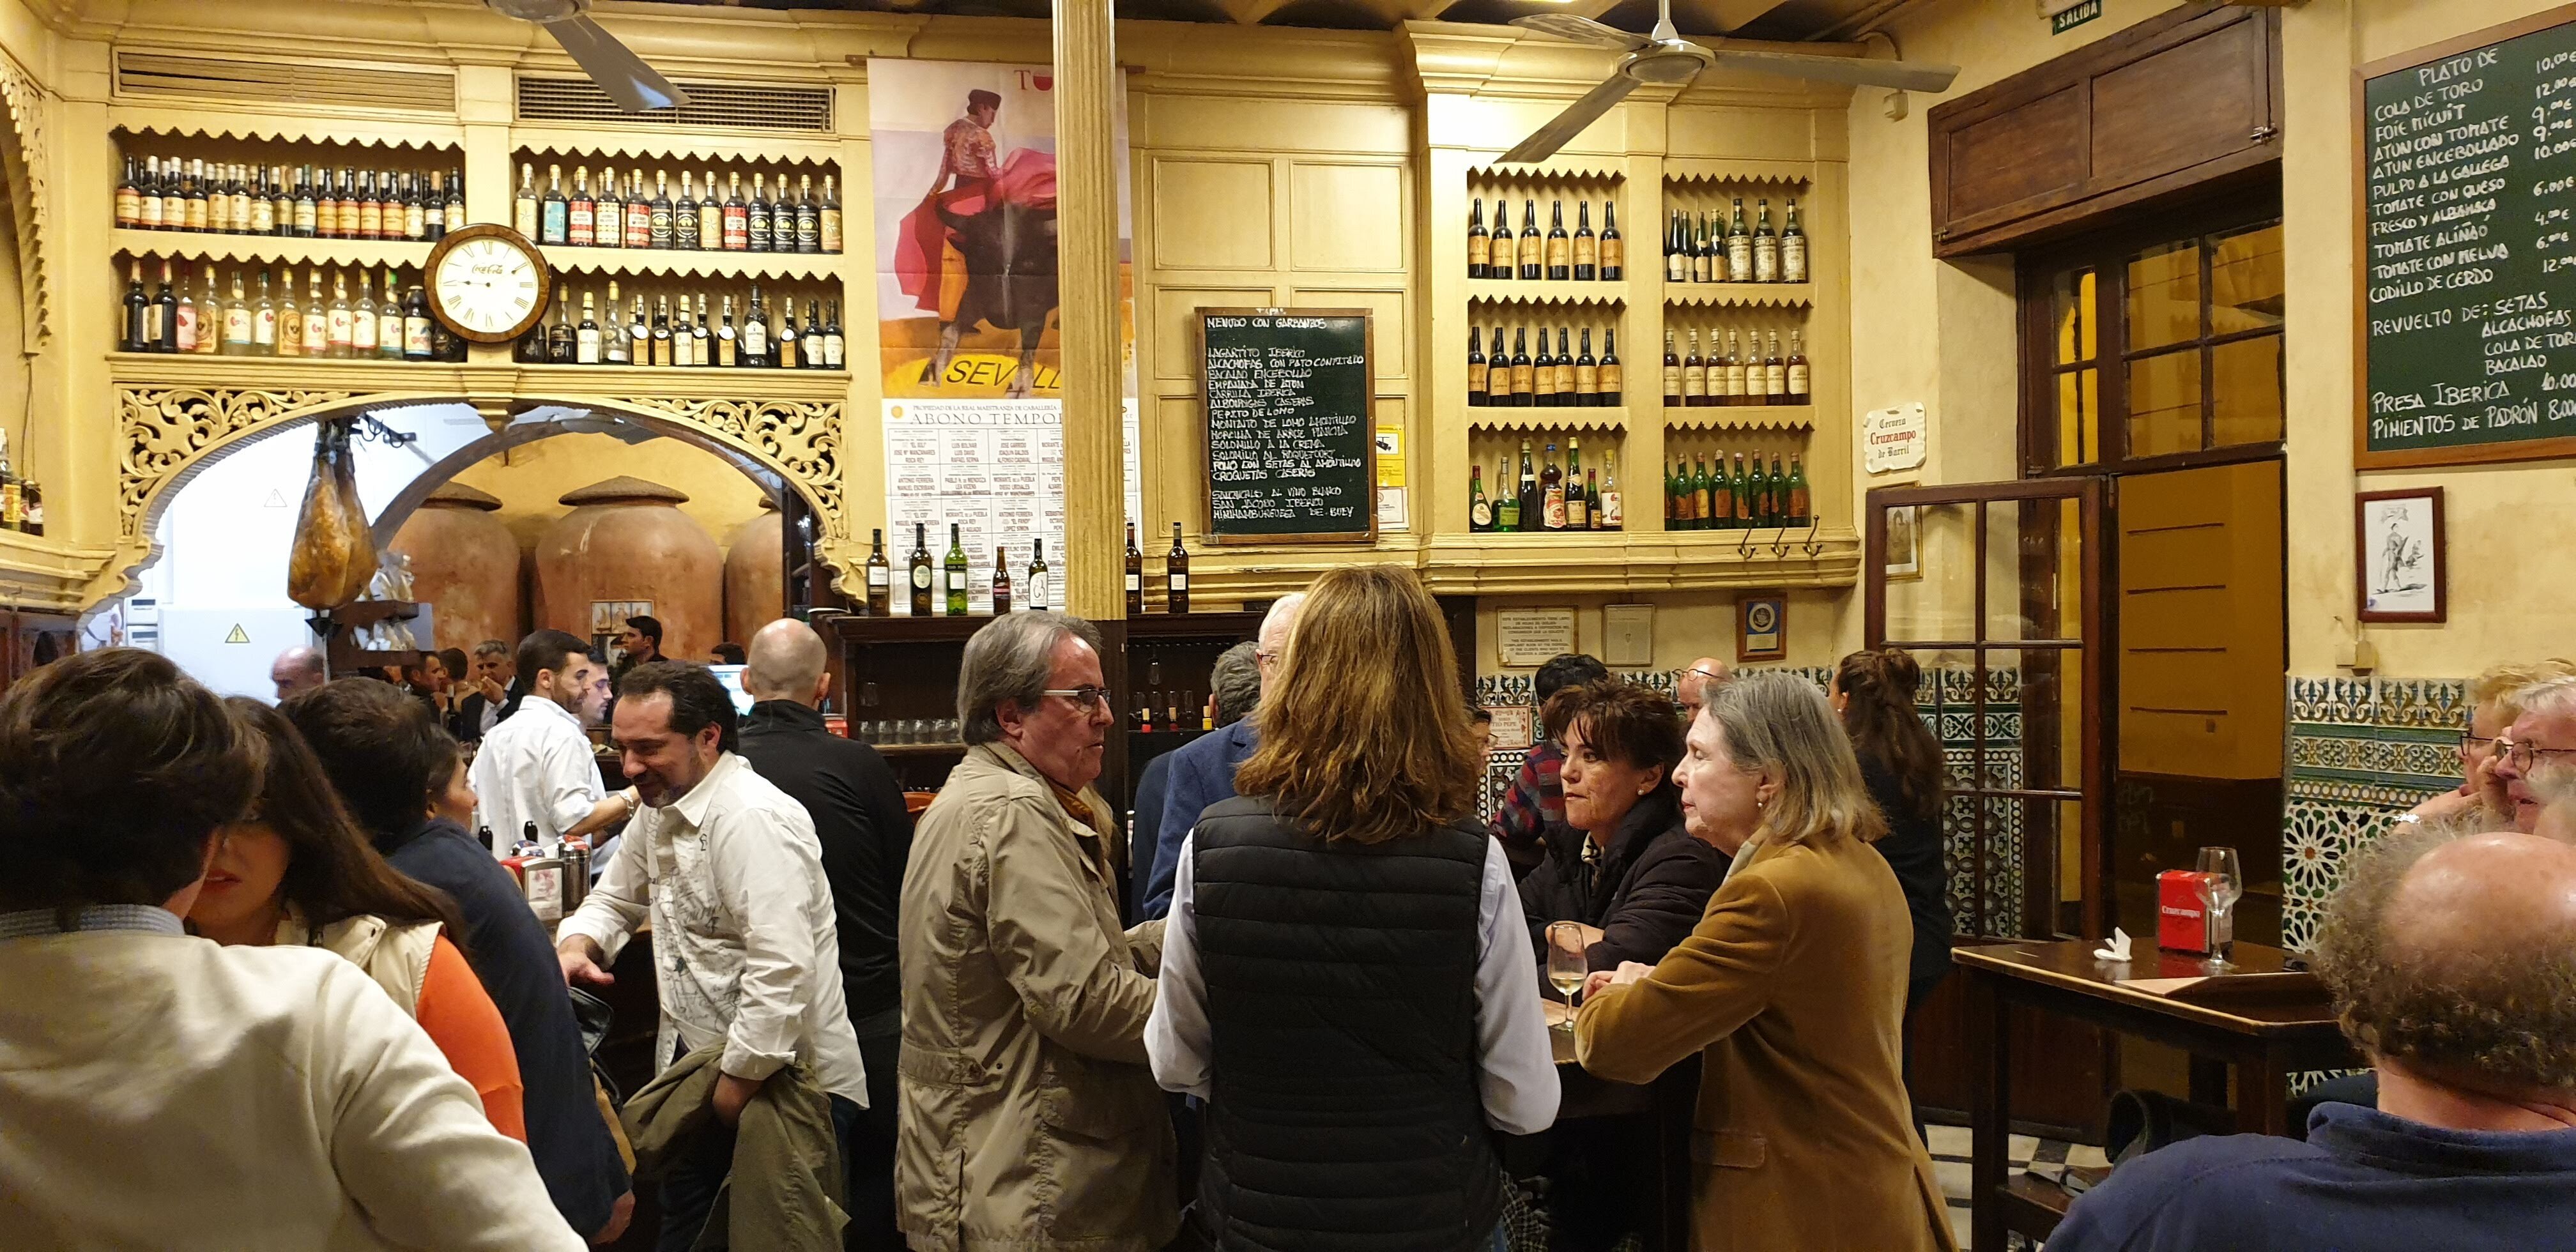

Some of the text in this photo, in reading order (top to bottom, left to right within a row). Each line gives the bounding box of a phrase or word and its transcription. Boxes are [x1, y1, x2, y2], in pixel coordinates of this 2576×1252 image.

[2058, 1, 2097, 29] SALIDA
[2419, 48, 2499, 86] PLATO DE
[2375, 101, 2411, 122] COLA
[2414, 92, 2434, 109] DE
[2438, 79, 2483, 101] TORO
[2373, 140, 2412, 162] ATUN
[2414, 132, 2442, 152] CON
[2446, 115, 2510, 142] TOMATE
[2375, 121, 2408, 142] FOIE
[2372, 158, 2412, 179] ATUN
[2416, 134, 2519, 169] ENCEBOLLADO
[2373, 178, 2415, 200] PULPO
[2418, 174, 2429, 188] A
[2433, 169, 2449, 185] LA
[2451, 155, 2510, 178] GALLEGA
[2373, 178, 2506, 216] TOMATE CON QUESO
[2372, 218, 2417, 236] FRESCO
[2420, 215, 2428, 227] Y
[2432, 198, 2496, 224] ALBAHACA
[2373, 235, 2431, 258] TOMATE
[2373, 258, 2423, 279] TOMATE
[2426, 252, 2455, 270] CON
[2458, 243, 2510, 264] MELVA
[2370, 280, 2424, 303] CODILLO
[2426, 275, 2443, 291] DE
[2446, 268, 2494, 289] CERDO
[1207, 317, 1327, 329] MENUDO CON GARBANZOS
[2373, 309, 2452, 337] REVUELTO
[2493, 291, 2549, 316] SETAS
[2481, 310, 2572, 338] ALCACHOFAS
[2485, 332, 2576, 356] COLA DE TOR
[1208, 355, 1364, 369] ALCACHOFAS CON PATO CONFITADO
[2484, 355, 2547, 376] BACALAO
[1208, 379, 1259, 389] EMPANADA
[1264, 379, 1276, 388] DE
[2372, 392, 2426, 413] PRESA
[910, 413, 981, 425] ABONO
[1211, 408, 1294, 419] PEPITO DE LOMO
[1262, 419, 1276, 428] DE
[1282, 418, 1305, 427] LOMO
[2373, 414, 2455, 439] PIMIENTOS
[2462, 416, 2480, 431] DE
[2485, 397, 2539, 428] PADRÓN
[1255, 431, 1271, 439] DE
[1268, 439, 1275, 448] A
[1279, 439, 1290, 448] LA
[1870, 430, 1916, 445] Cruzcampo
[1241, 460, 1259, 469] CON
[1265, 460, 1295, 468] SETAS
[1300, 460, 1312, 468] AL
[1263, 450, 1278, 460] AL
[1213, 470, 1268, 481] CROQUETAS
[1287, 487, 1306, 496] VINO
[1213, 500, 1234, 509] SAN
[1308, 507, 1324, 516] DE
[1330, 507, 1354, 517] BUEY
